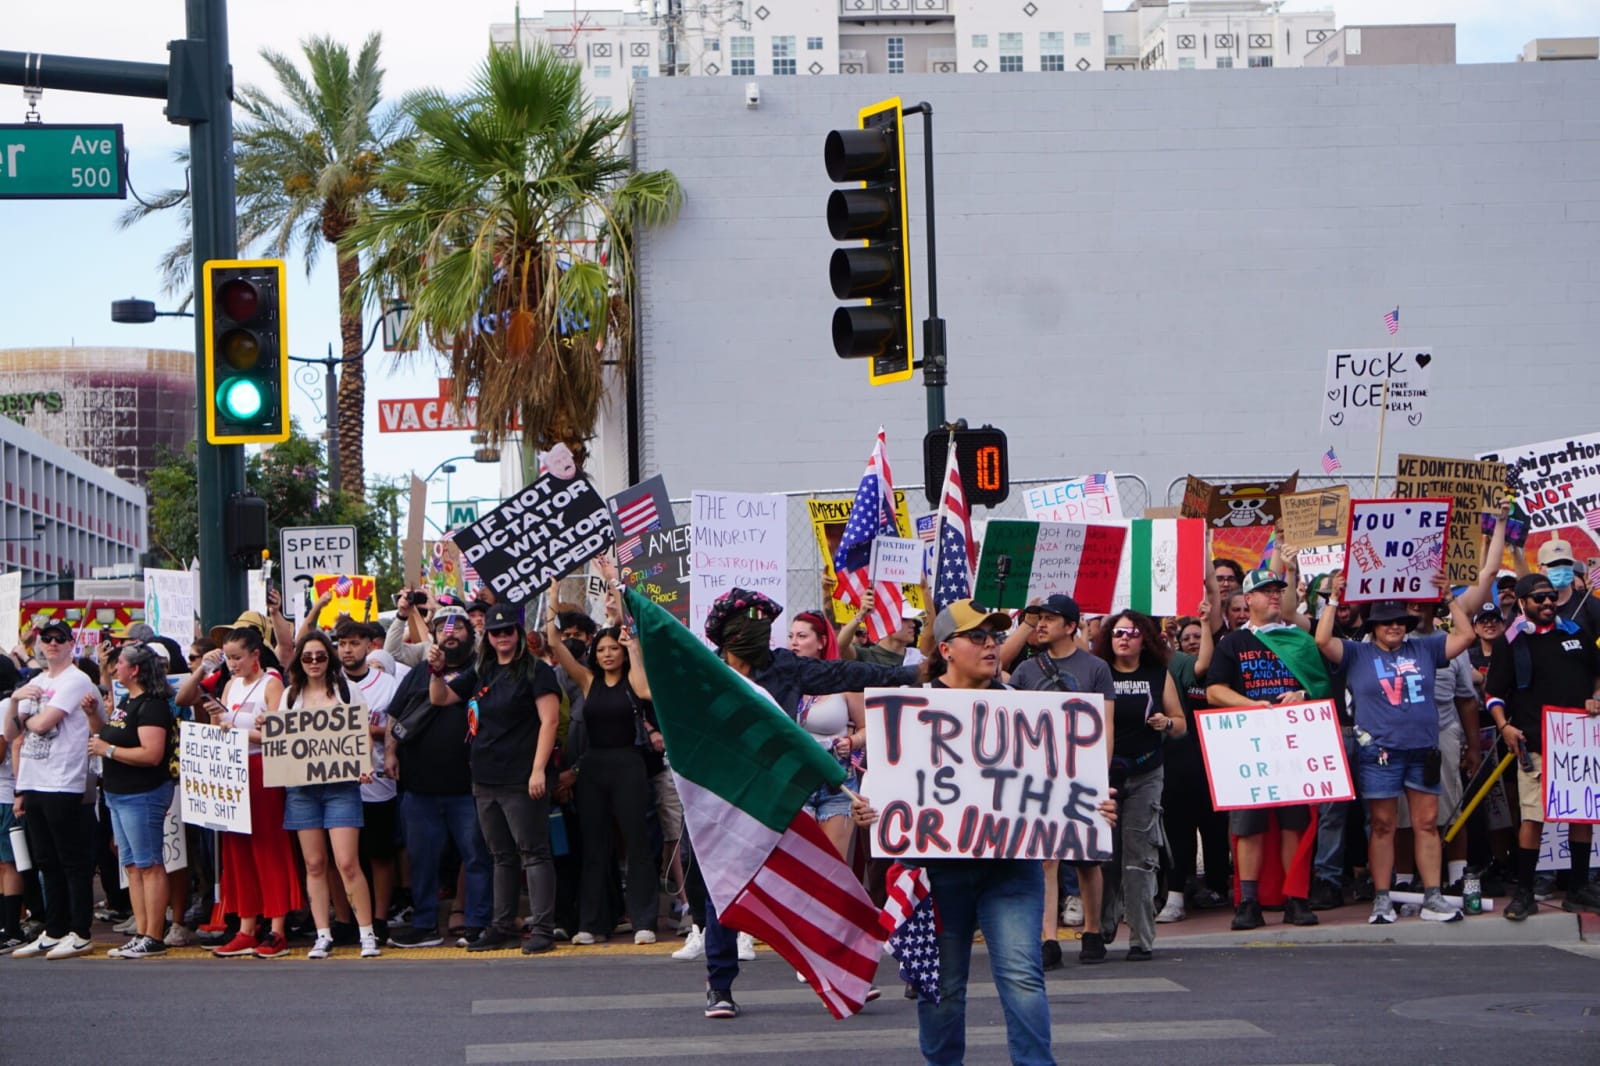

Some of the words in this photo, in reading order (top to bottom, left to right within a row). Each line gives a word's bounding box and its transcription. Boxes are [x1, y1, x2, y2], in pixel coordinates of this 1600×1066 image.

[71, 135, 112, 154] Ave
[72, 168, 110, 187] 500
[1336, 352, 1407, 379] FUCK
[1343, 384, 1383, 408] ICE
[1391, 401, 1412, 411] BLM
[977, 446, 999, 490] 10
[1399, 459, 1417, 476] WE
[1482, 464, 1506, 482] LIKE
[1430, 481, 1453, 492] THE
[1456, 482, 1482, 494] ONLY
[1524, 483, 1573, 514] NOT
[472, 515, 498, 539] IF
[501, 478, 551, 522] NOT
[696, 495, 727, 520] THE
[737, 499, 777, 518] ONLY
[464, 480, 589, 563] DICTATOR
[288, 537, 350, 552] SPEED
[504, 511, 565, 558] WHY
[695, 527, 766, 548] MINORITY
[878, 540, 916, 550] FOXTROT
[1039, 527, 1060, 541] got
[1066, 527, 1081, 538] no
[490, 508, 610, 592] DICTATOR
[882, 554, 908, 563] DELTA
[1385, 541, 1414, 557] NO
[506, 525, 614, 603] SHAPED?
[884, 568, 905, 576] TACO
[647, 583, 661, 594] PRO
[698, 574, 726, 588] THE
[734, 576, 781, 587] COUNTRY
[1360, 577, 1420, 594] KING
[651, 591, 677, 603] CHOICE
[1239, 650, 1261, 660] HEY
[1241, 659, 1275, 672] FUCK
[1253, 671, 1272, 679] AND
[188, 724, 195, 736] I
[201, 727, 238, 741] CANNOT
[265, 706, 361, 738] DEPOSE
[1550, 711, 1575, 747] WE
[262, 740, 288, 757] THE
[292, 735, 367, 760] ORANGE
[865, 695, 1104, 779] TRUMP
[186, 742, 221, 761] BELIEVE
[228, 749, 242, 764] WE
[181, 761, 202, 774] STILL
[209, 764, 231, 781] HAVE
[236, 767, 247, 783] TO
[185, 780, 242, 803] PROTEST
[916, 766, 961, 807] IS
[980, 770, 1099, 826] THE
[1547, 781, 1577, 818] ALL
[189, 798, 207, 814] THIS
[215, 802, 237, 820] SHIT
[878, 800, 1113, 861] CRIMINAL
